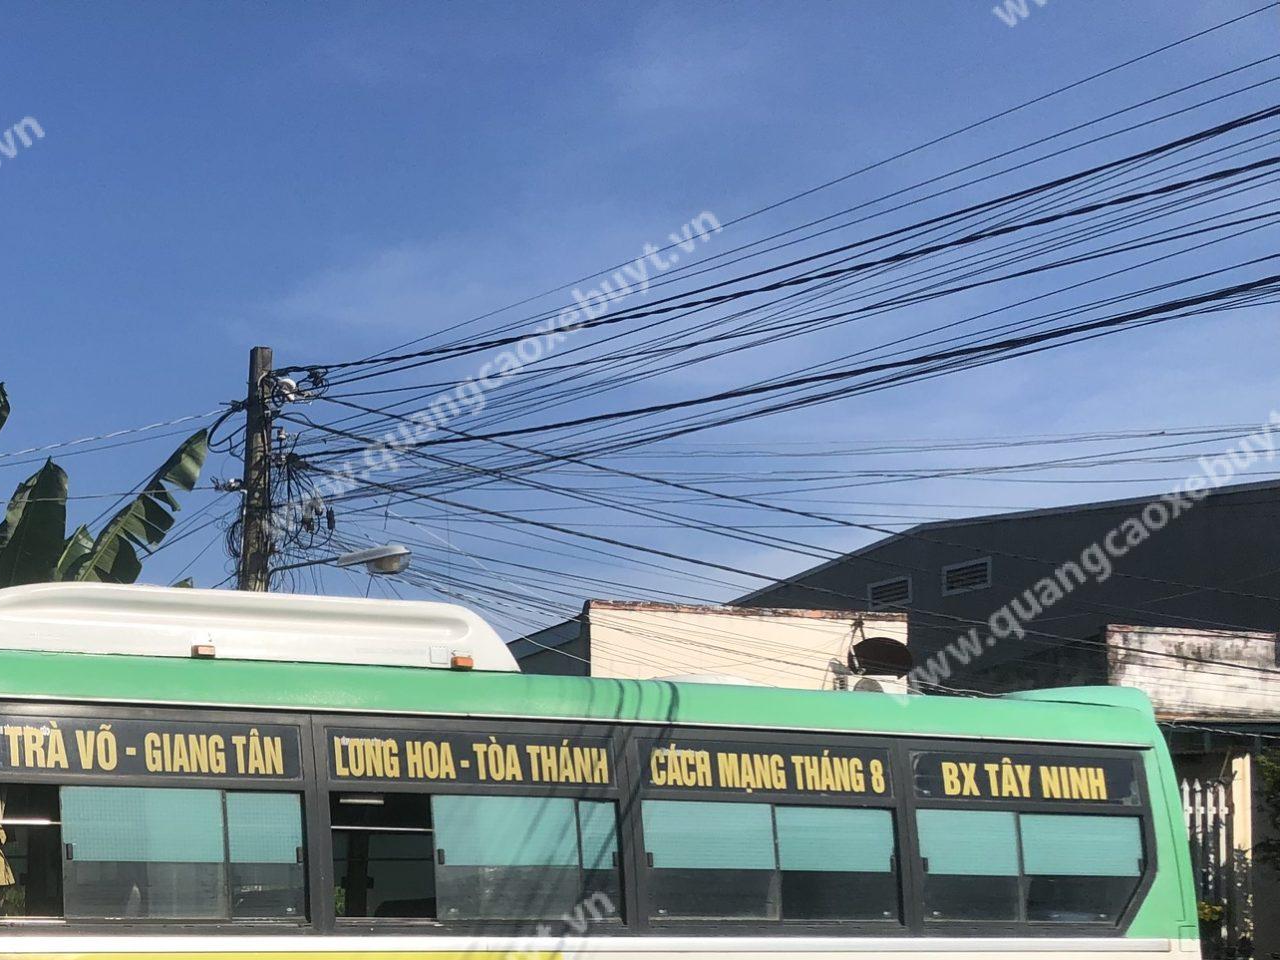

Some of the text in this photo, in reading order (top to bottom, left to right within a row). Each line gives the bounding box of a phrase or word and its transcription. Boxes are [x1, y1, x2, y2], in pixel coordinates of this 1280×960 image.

[4, 720, 69, 769] TRÀ
[76, 724, 117, 771] VÕ
[144, 732, 226, 774] GIANG
[231, 728, 284, 775] TÂN
[334, 736, 400, 778] LONG
[406, 741, 456, 780] HOA
[473, 736, 523, 781] TÒA
[526, 739, 609, 784] THÁNH
[651, 743, 885, 794] CÁCH MẠNG THÁNG 8
[941, 757, 1107, 800] BX TÂY NINH
